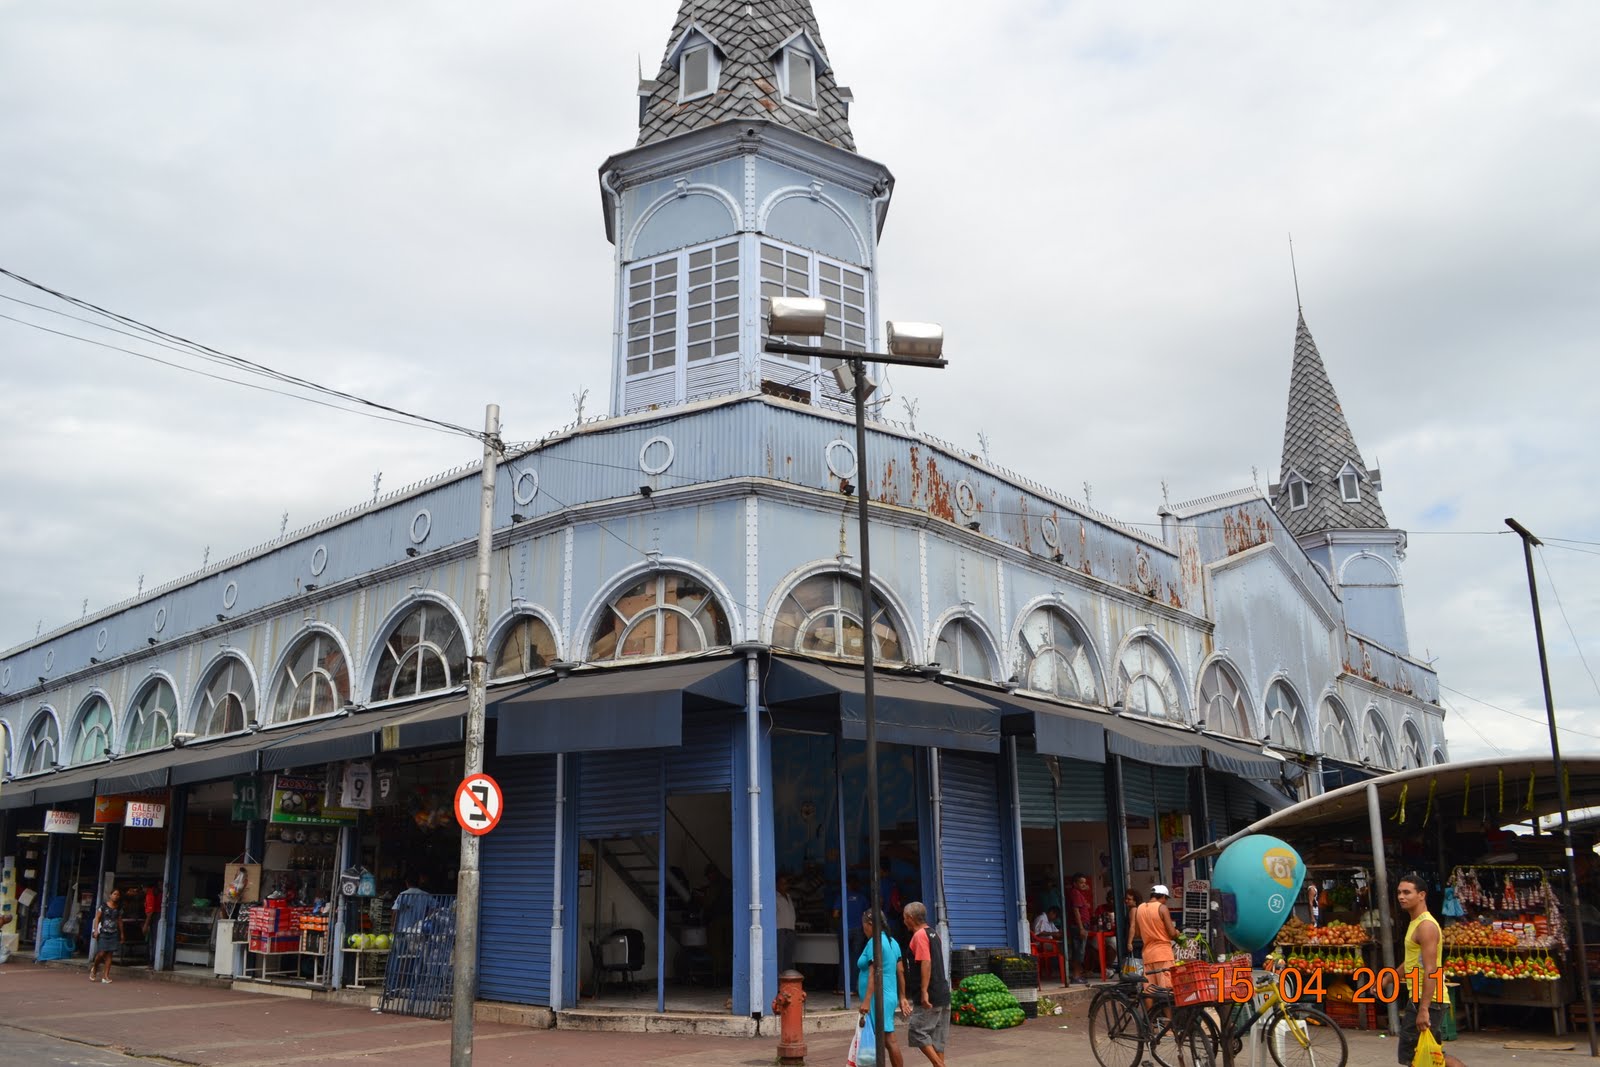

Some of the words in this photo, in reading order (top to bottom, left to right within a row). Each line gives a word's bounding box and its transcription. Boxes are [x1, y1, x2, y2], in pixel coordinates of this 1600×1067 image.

[240, 786, 256, 802] 10
[131, 803, 162, 812] GALETO
[51, 811, 77, 819] FRANGO
[1271, 898, 1281, 909] 31
